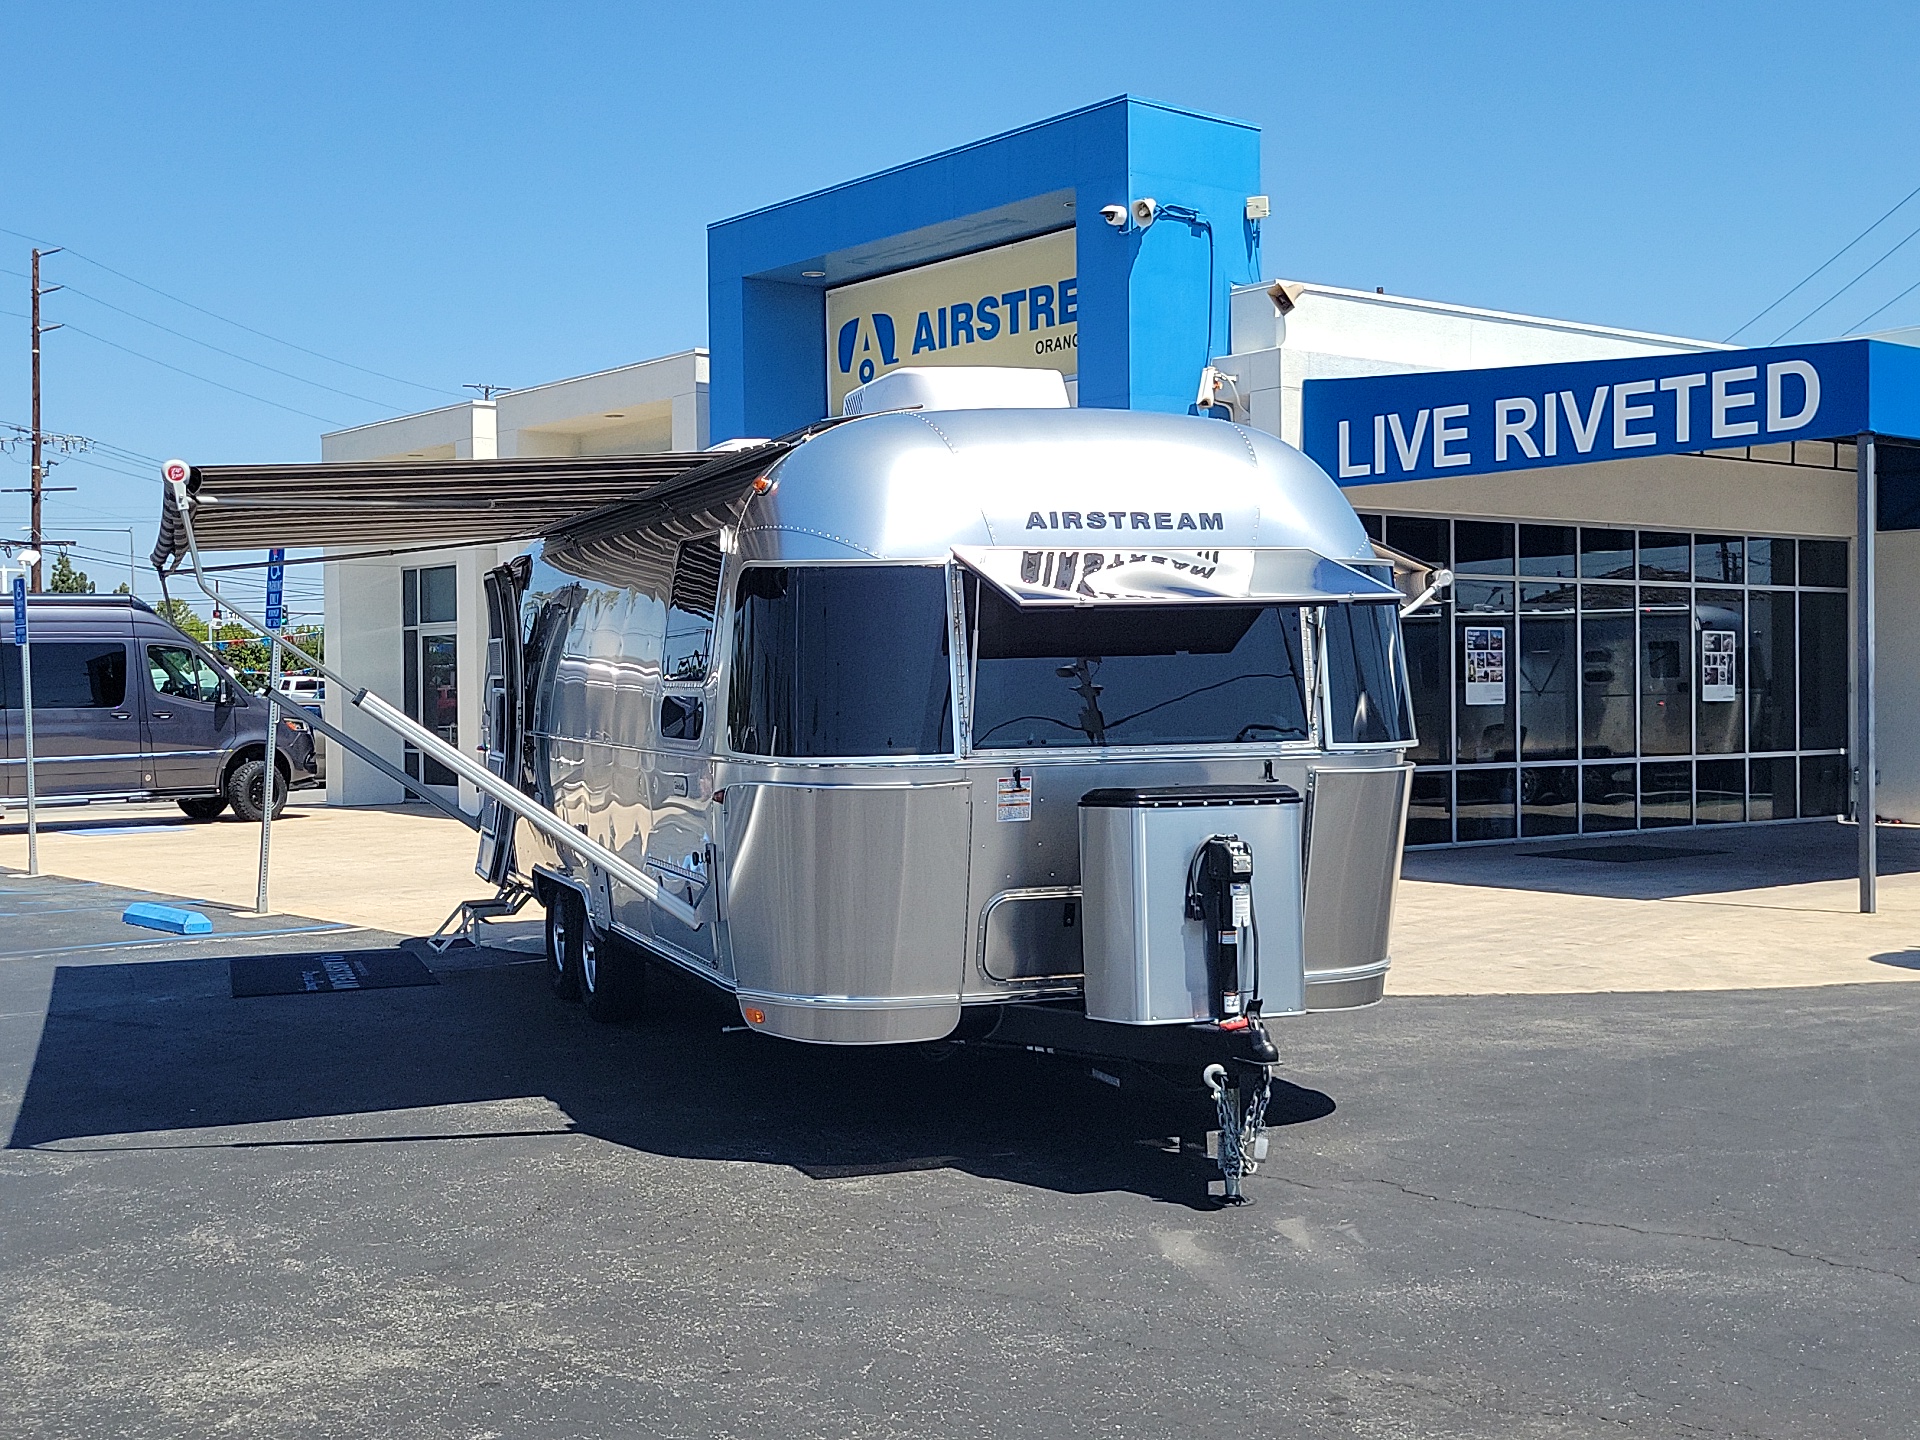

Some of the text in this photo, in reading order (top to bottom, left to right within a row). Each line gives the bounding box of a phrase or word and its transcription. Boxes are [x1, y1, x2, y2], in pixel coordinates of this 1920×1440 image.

[1338, 359, 1821, 479] LIVE RIVETED
[1025, 511, 1224, 530] AIRSTREAM
